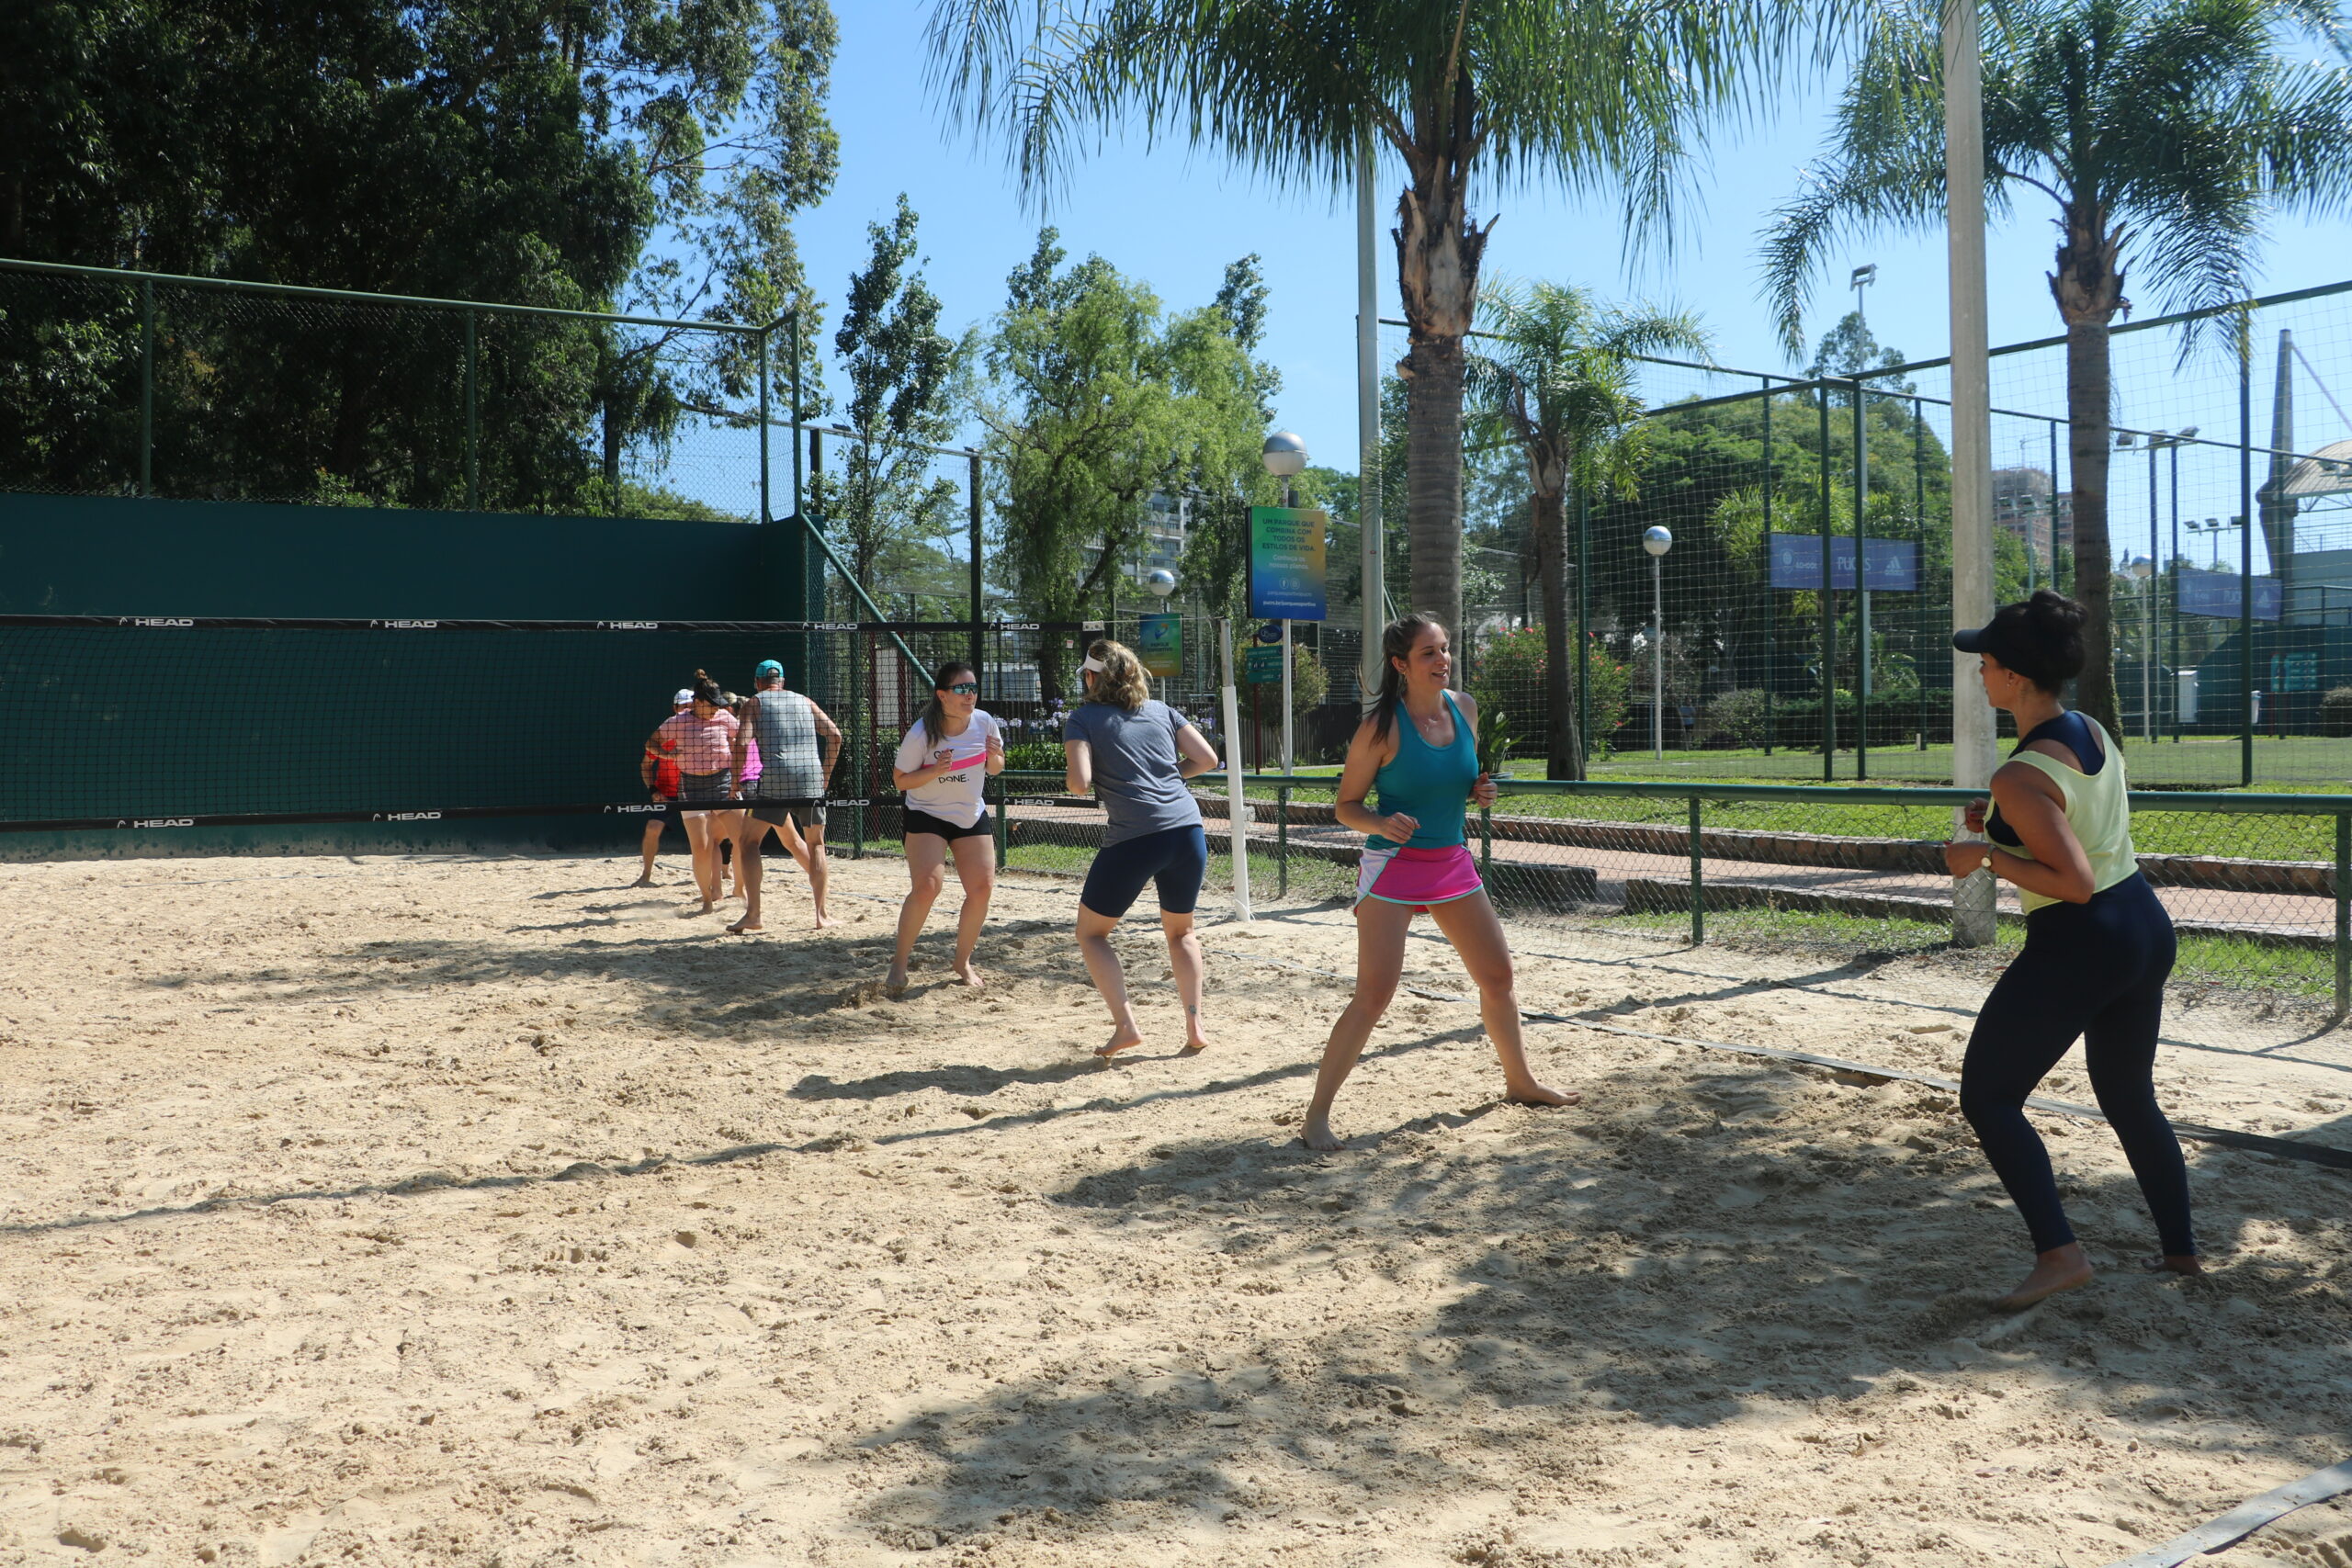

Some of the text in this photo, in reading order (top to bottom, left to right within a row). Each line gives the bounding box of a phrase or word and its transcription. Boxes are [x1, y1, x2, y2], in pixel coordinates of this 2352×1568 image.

[1273, 518, 1301, 526] PARQUE
[1266, 526, 1296, 535] COMBINA
[136, 618, 194, 626] HEAD
[385, 620, 438, 628] HEAD
[610, 621, 658, 629] HEAD
[938, 773, 970, 784] DONE.
[1013, 798, 1055, 807] HEAD
[617, 805, 666, 813] HEAD
[388, 812, 441, 821] HEAD
[133, 819, 194, 829] HEAD
